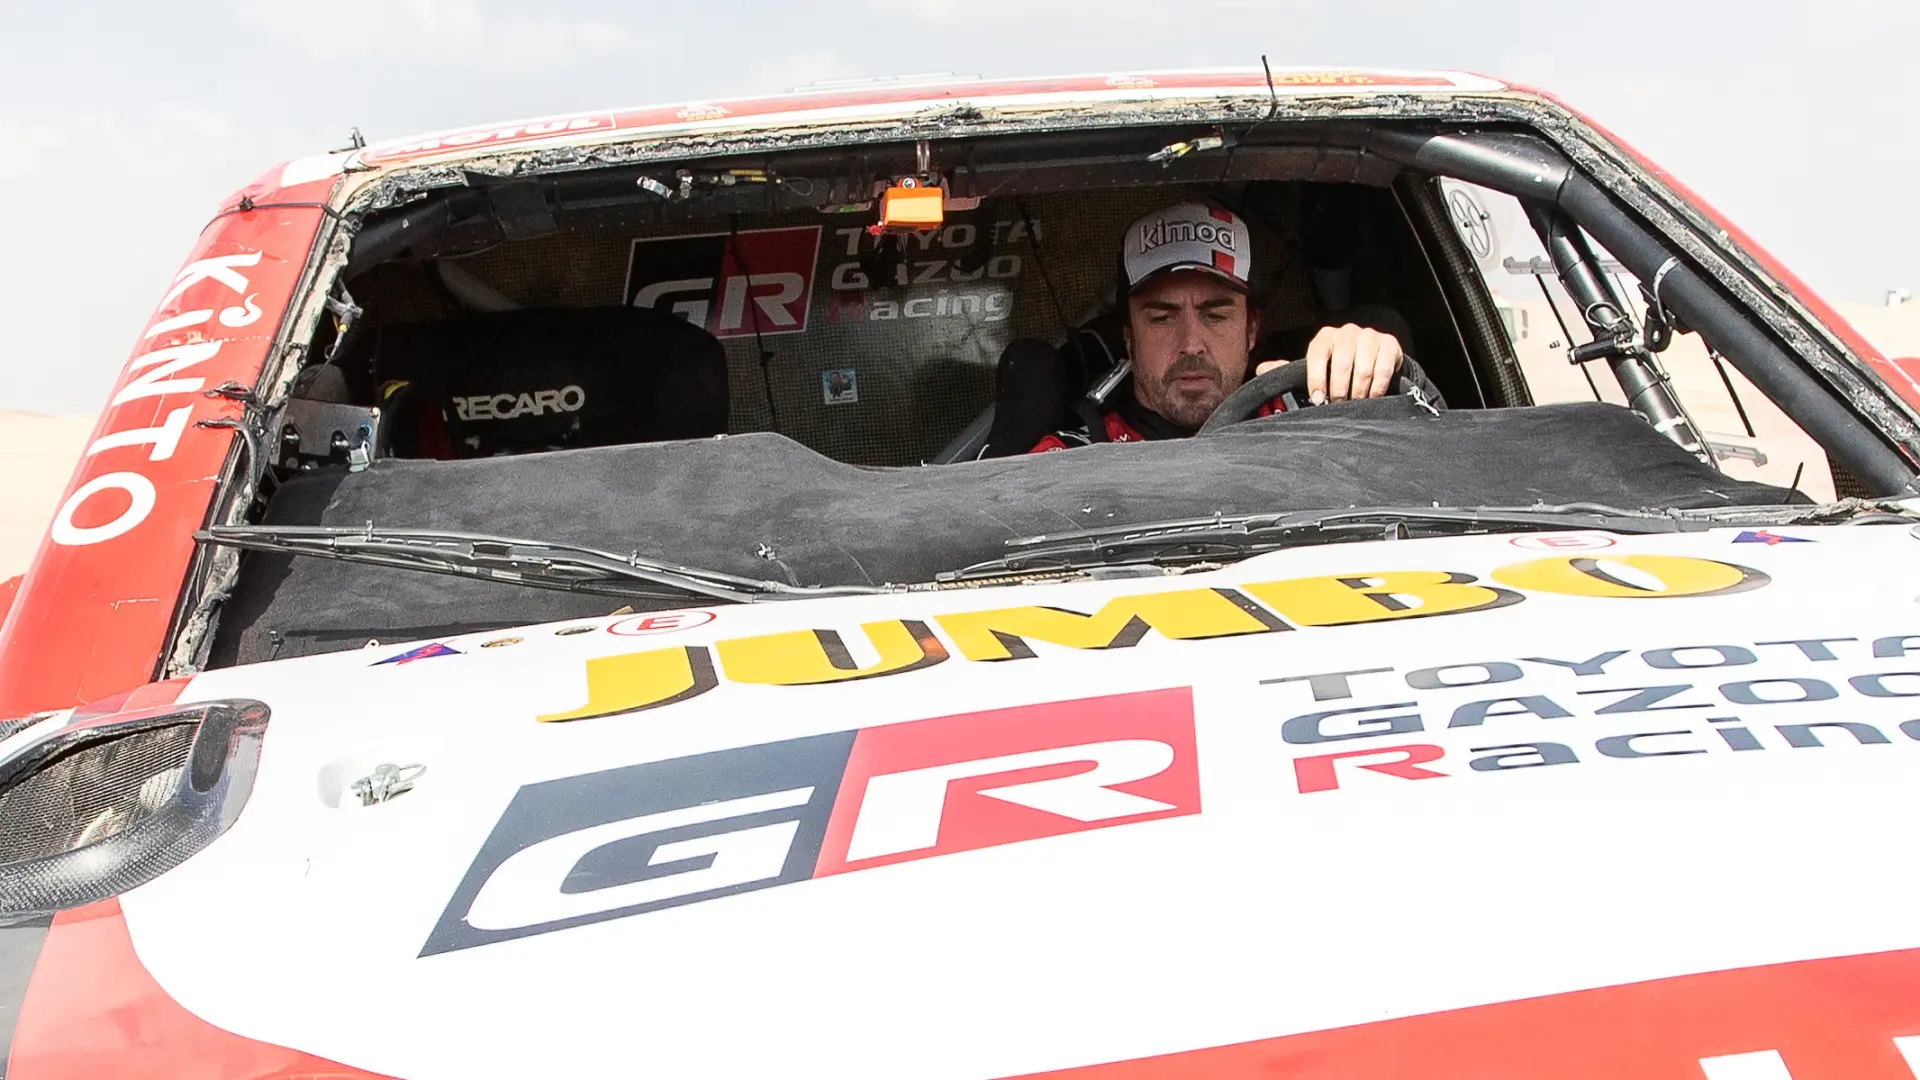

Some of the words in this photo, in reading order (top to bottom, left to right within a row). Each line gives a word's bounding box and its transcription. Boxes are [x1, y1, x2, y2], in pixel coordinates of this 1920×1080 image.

[835, 218, 1043, 256] TYOTA
[1139, 217, 1236, 254] kimoa
[825, 288, 1014, 323] Racing
[442, 384, 586, 422] RECARO
[536, 554, 1772, 723] JUMBO
[1292, 716, 1920, 795] Racin
[461, 738, 1178, 931] GR
